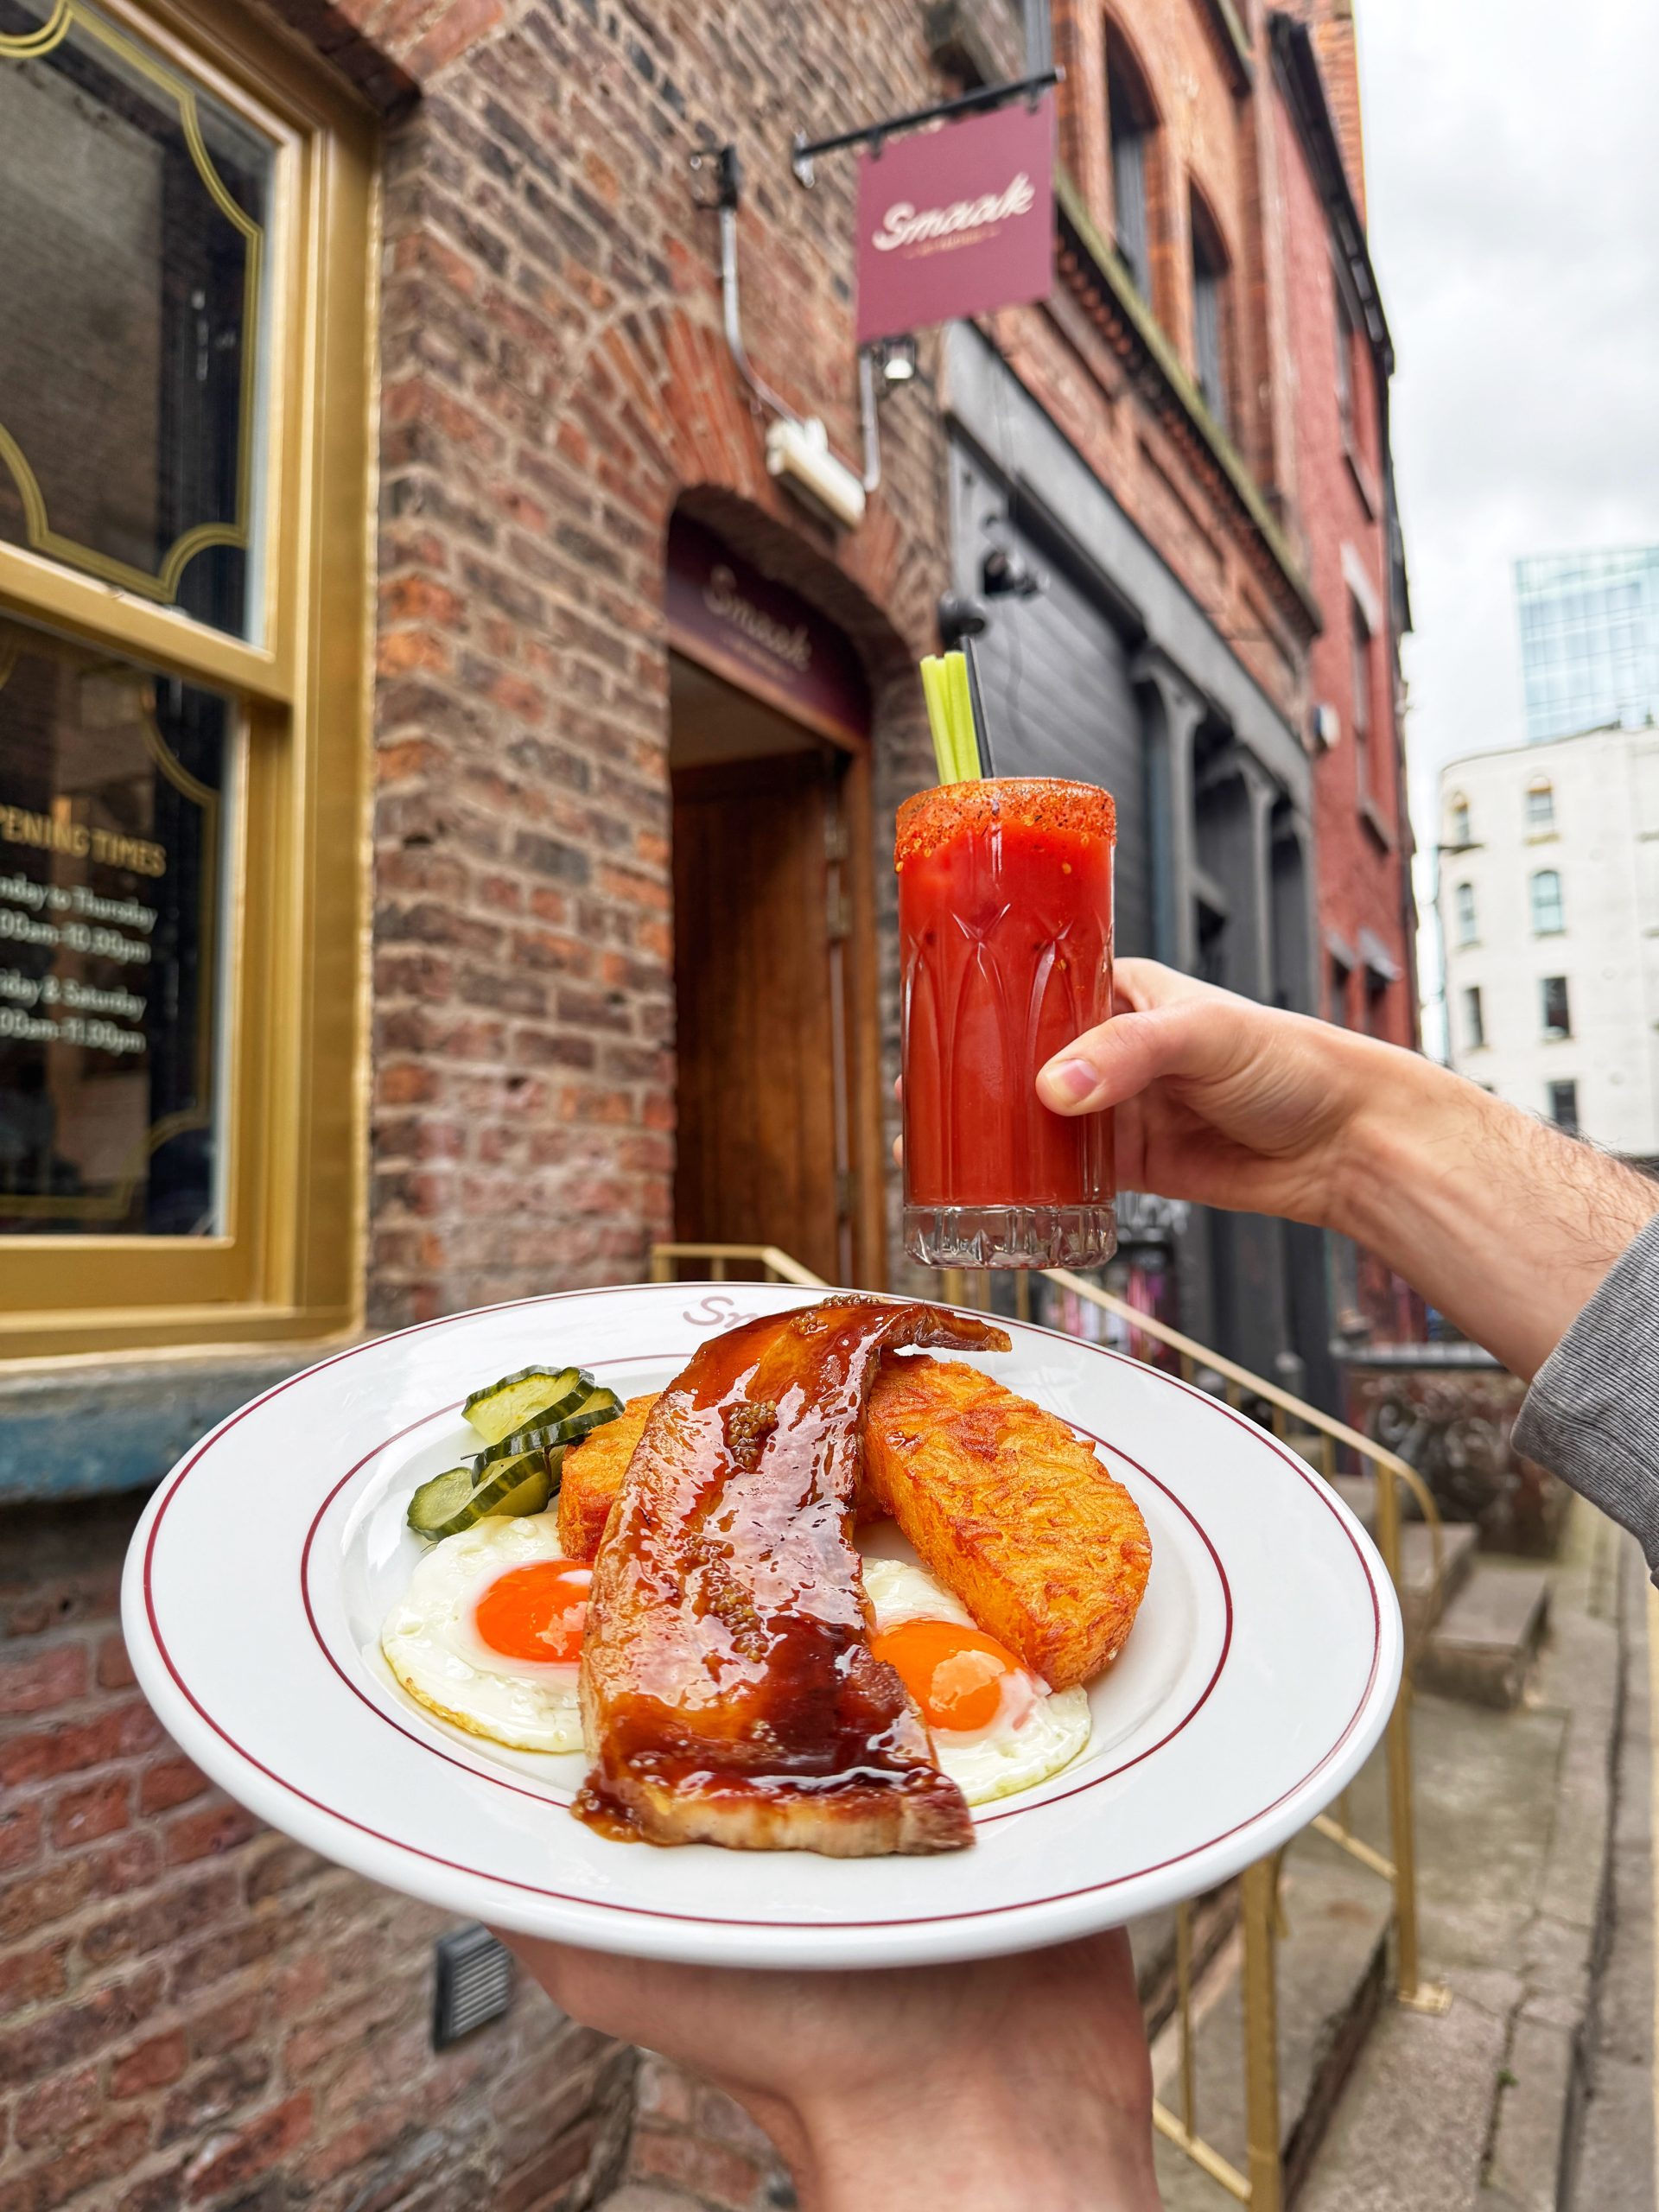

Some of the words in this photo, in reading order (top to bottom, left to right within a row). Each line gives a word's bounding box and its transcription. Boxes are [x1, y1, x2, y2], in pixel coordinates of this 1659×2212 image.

[872, 172, 1035, 251] Smaak
[91, 827, 167, 878] TIMES
[46, 885, 72, 912] to
[71, 885, 158, 934] Thursday
[60, 977, 147, 1023] Saturday
